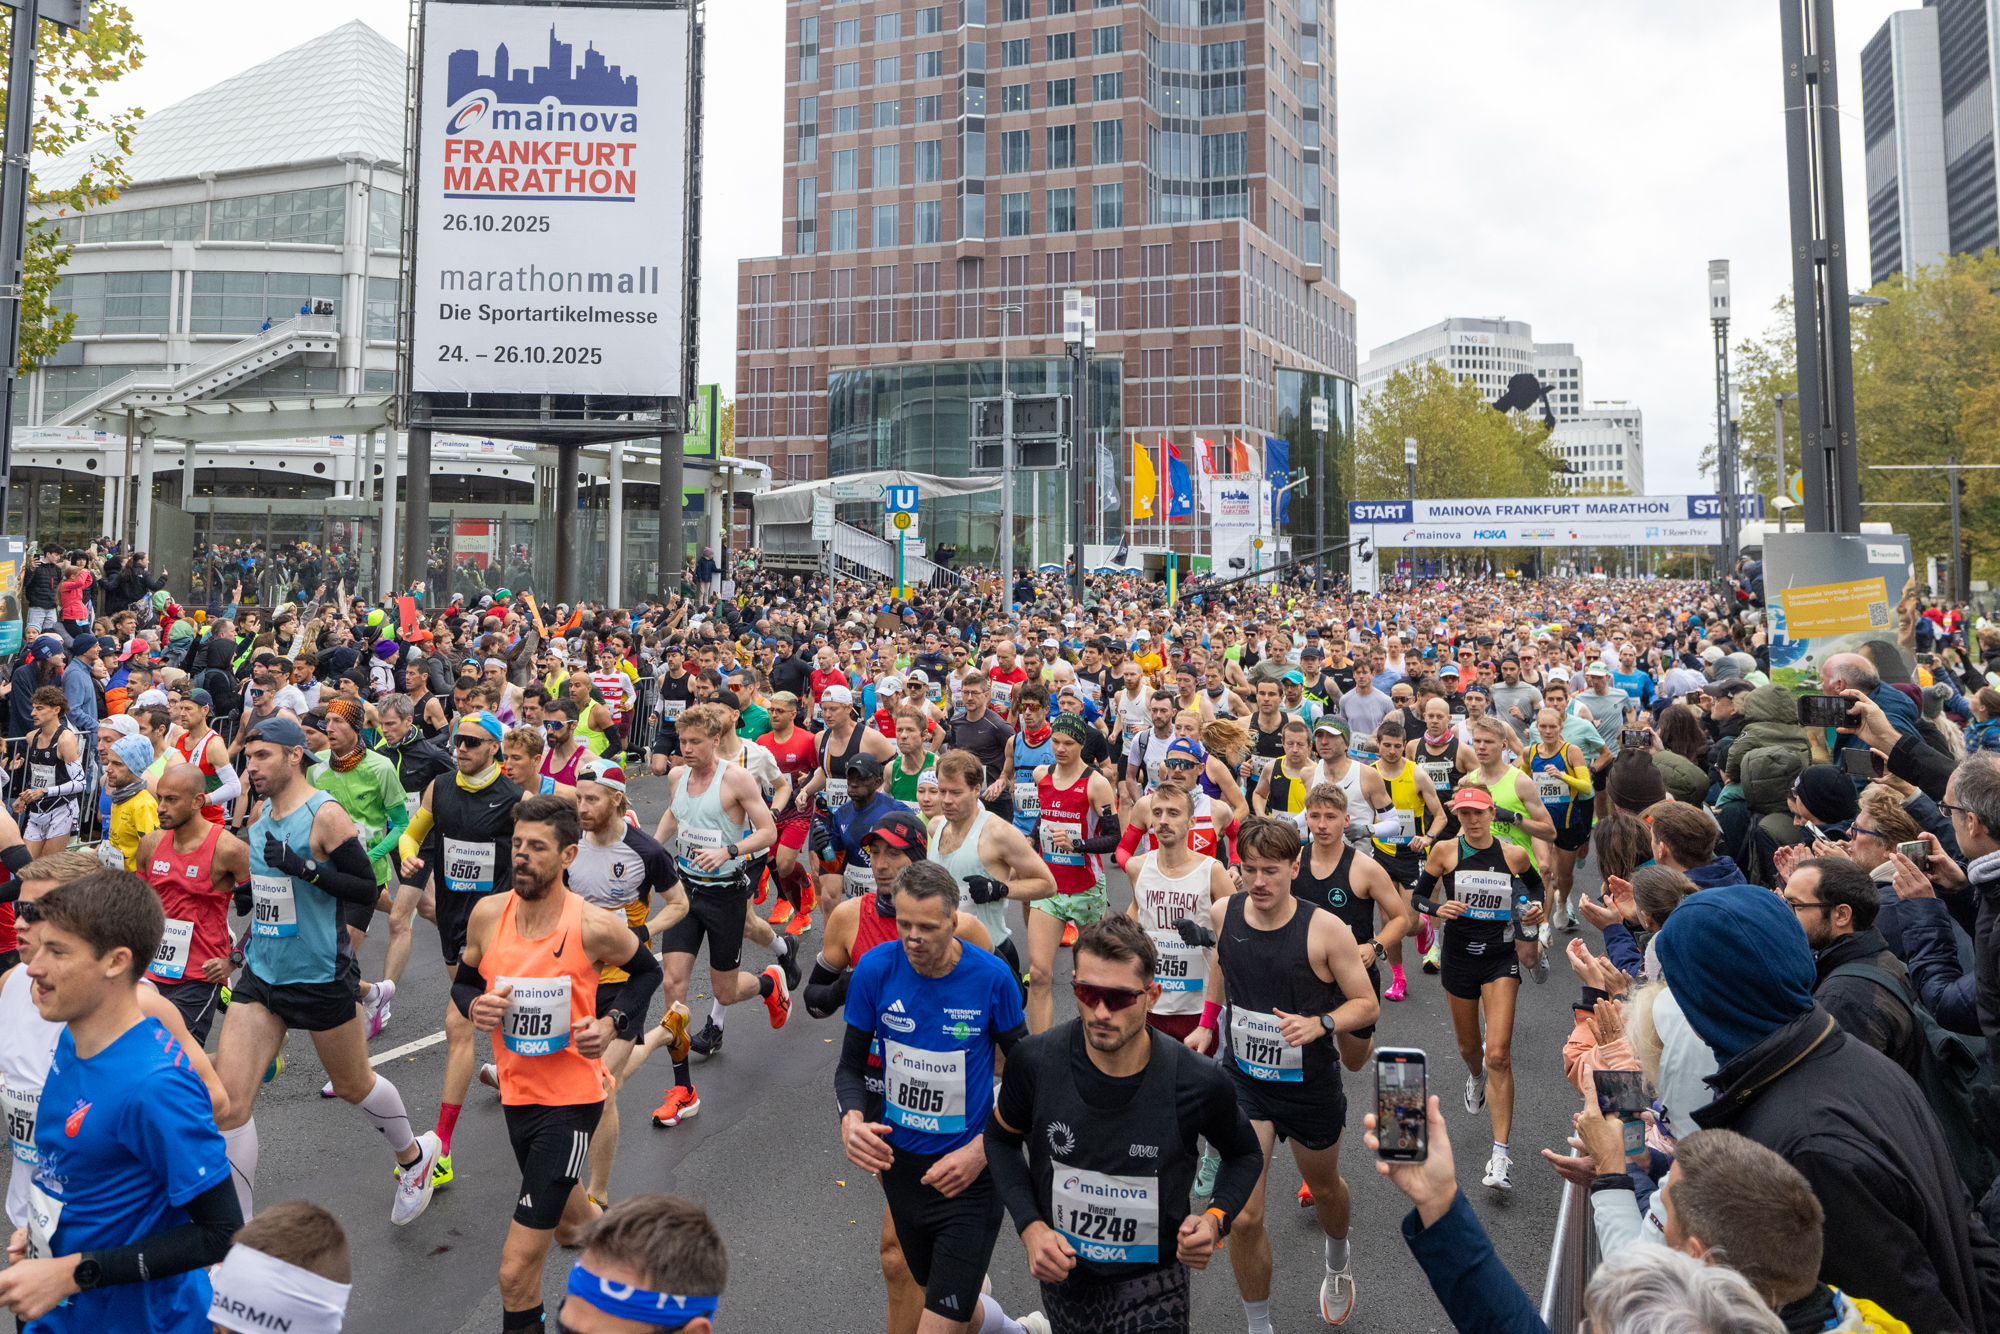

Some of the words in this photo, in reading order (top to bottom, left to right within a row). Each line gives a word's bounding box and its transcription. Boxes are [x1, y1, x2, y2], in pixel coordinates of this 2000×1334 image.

[492, 104, 638, 133] mainova
[444, 139, 637, 167] FRANKFURT
[443, 166, 636, 194] MARATHON
[442, 214, 550, 232] 26.10.2025
[440, 264, 659, 294] marathonmall
[439, 304, 472, 320] Die
[478, 304, 658, 324] Sportartikelmesse
[1459, 334, 1478, 344] ING
[438, 345, 469, 362] 24.
[494, 346, 602, 365] 26.10.2025
[684, 436, 707, 446] HOPPING
[896, 490, 914, 509] U
[1354, 505, 1406, 520] START
[1429, 506, 1492, 516] MAINOVA
[1496, 504, 1580, 516] FRANKFURT
[1586, 502, 1670, 514] MARATHON
[899, 516, 906, 525] H
[1416, 530, 1462, 540] mainova
[1474, 530, 1507, 540] HOKA
[1788, 590, 1822, 600] Spannende
[1823, 588, 1848, 597] Vorträge
[1789, 597, 1829, 607] Diskussionen
[1851, 591, 1880, 600] Experimente
[1540, 786, 1561, 795] F2581
[832, 796, 848, 806] 9127
[1022, 799, 1040, 809] 8675
[688, 833, 716, 842] mainova
[456, 848, 490, 856] mainova
[1052, 856, 1071, 864] HOKA
[450, 863, 481, 879] 9503
[256, 884, 287, 893] mainova
[452, 881, 476, 890] HOKA
[1472, 877, 1506, 886] mainova
[1169, 892, 1199, 915] TRACK
[1465, 892, 1502, 909] F2809
[256, 903, 279, 922] 6074
[1470, 910, 1495, 918] HOKA
[257, 925, 279, 936] HOKA
[1156, 960, 1188, 977] 5459
[1159, 980, 1186, 990] HOKA
[514, 988, 564, 998] mainova
[512, 1014, 552, 1036] 7303
[1248, 1021, 1281, 1033] maino
[516, 1040, 550, 1054] HOKA
[1247, 1034, 1265, 1043] Vegard
[1266, 1037, 1279, 1046] Lund
[1246, 1042, 1282, 1065] 11211
[904, 1057, 956, 1073] mainova
[1248, 1065, 1280, 1079] HOKA
[910, 1077, 928, 1089] Denny
[898, 1083, 944, 1112] 8605
[14, 1107, 32, 1119] Petter
[901, 1112, 940, 1131] HOKA
[1081, 1184, 1147, 1199] mainova
[1088, 1203, 1116, 1216] Vincent
[1070, 1210, 1137, 1242] 12248
[1080, 1243, 1127, 1260] HOKA
[213, 1292, 292, 1332] GARMIN
